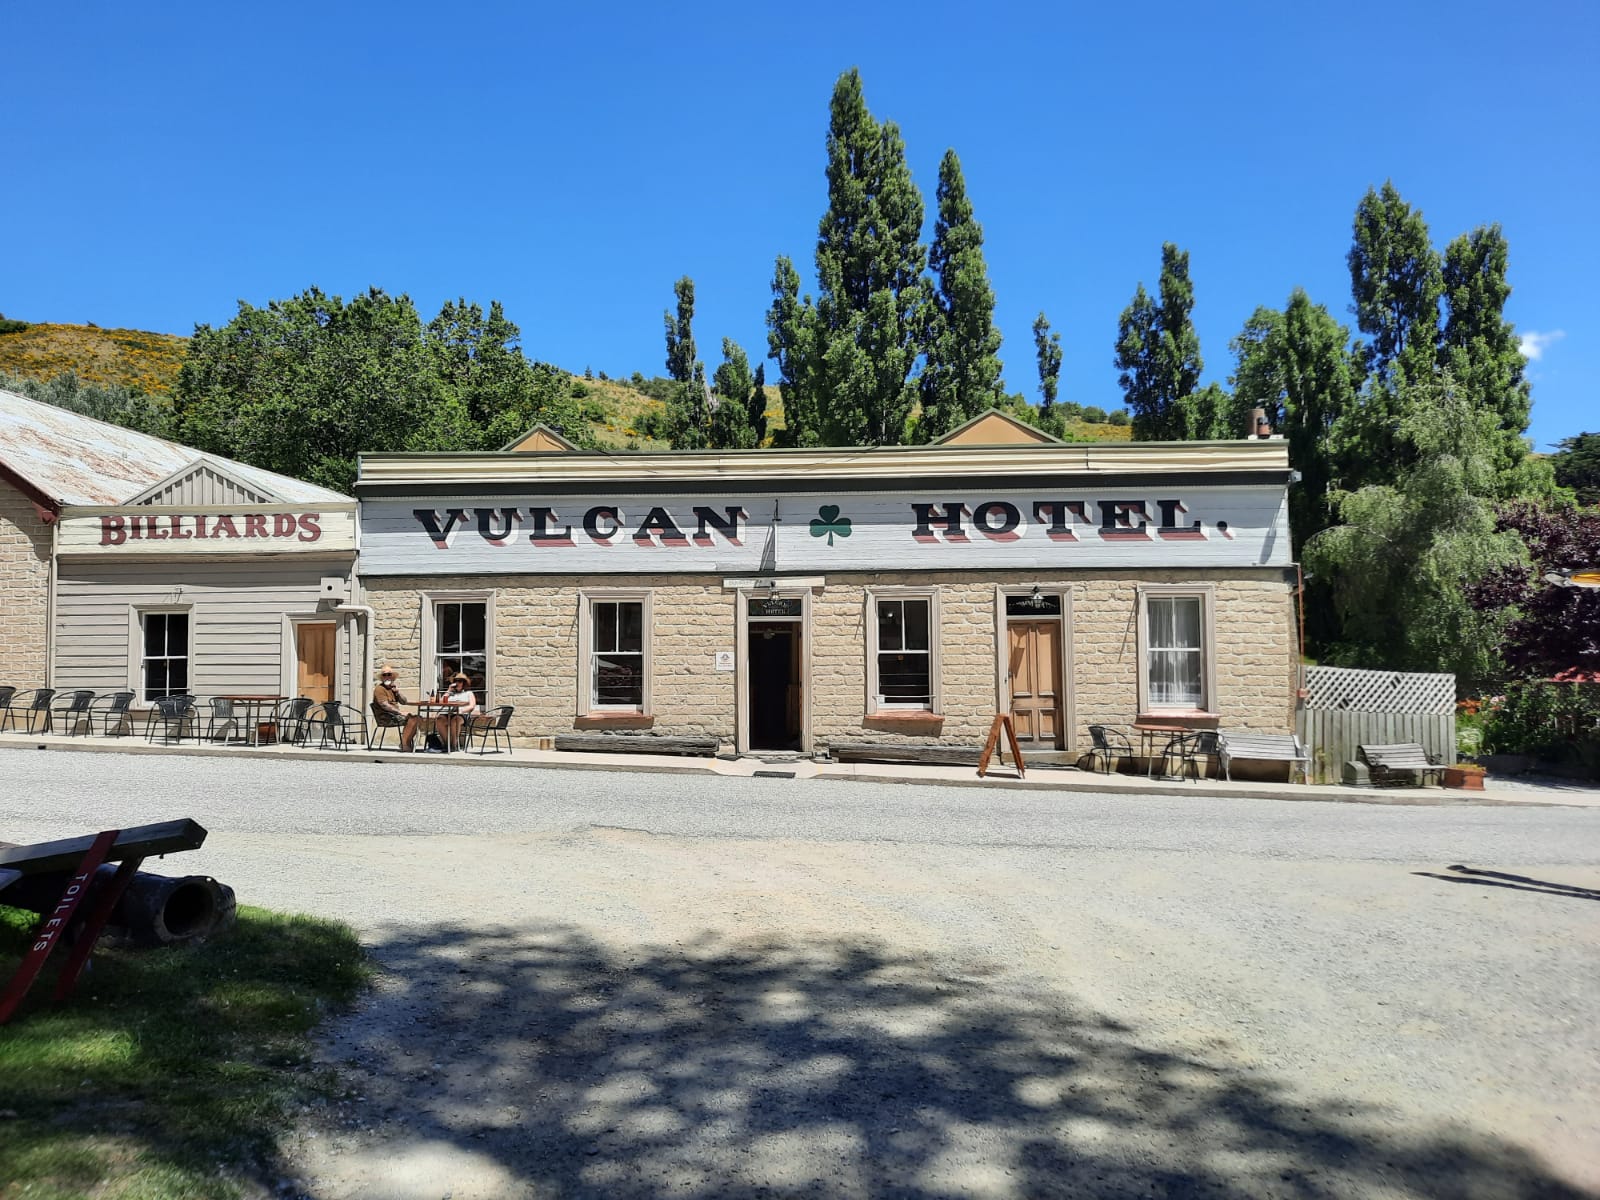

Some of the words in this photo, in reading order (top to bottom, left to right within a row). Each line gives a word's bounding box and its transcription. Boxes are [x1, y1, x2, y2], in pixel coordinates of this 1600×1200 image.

[99, 513, 322, 546] BILLIARDS
[412, 506, 749, 550] VULCAN
[33, 872, 89, 952] TOILETS
